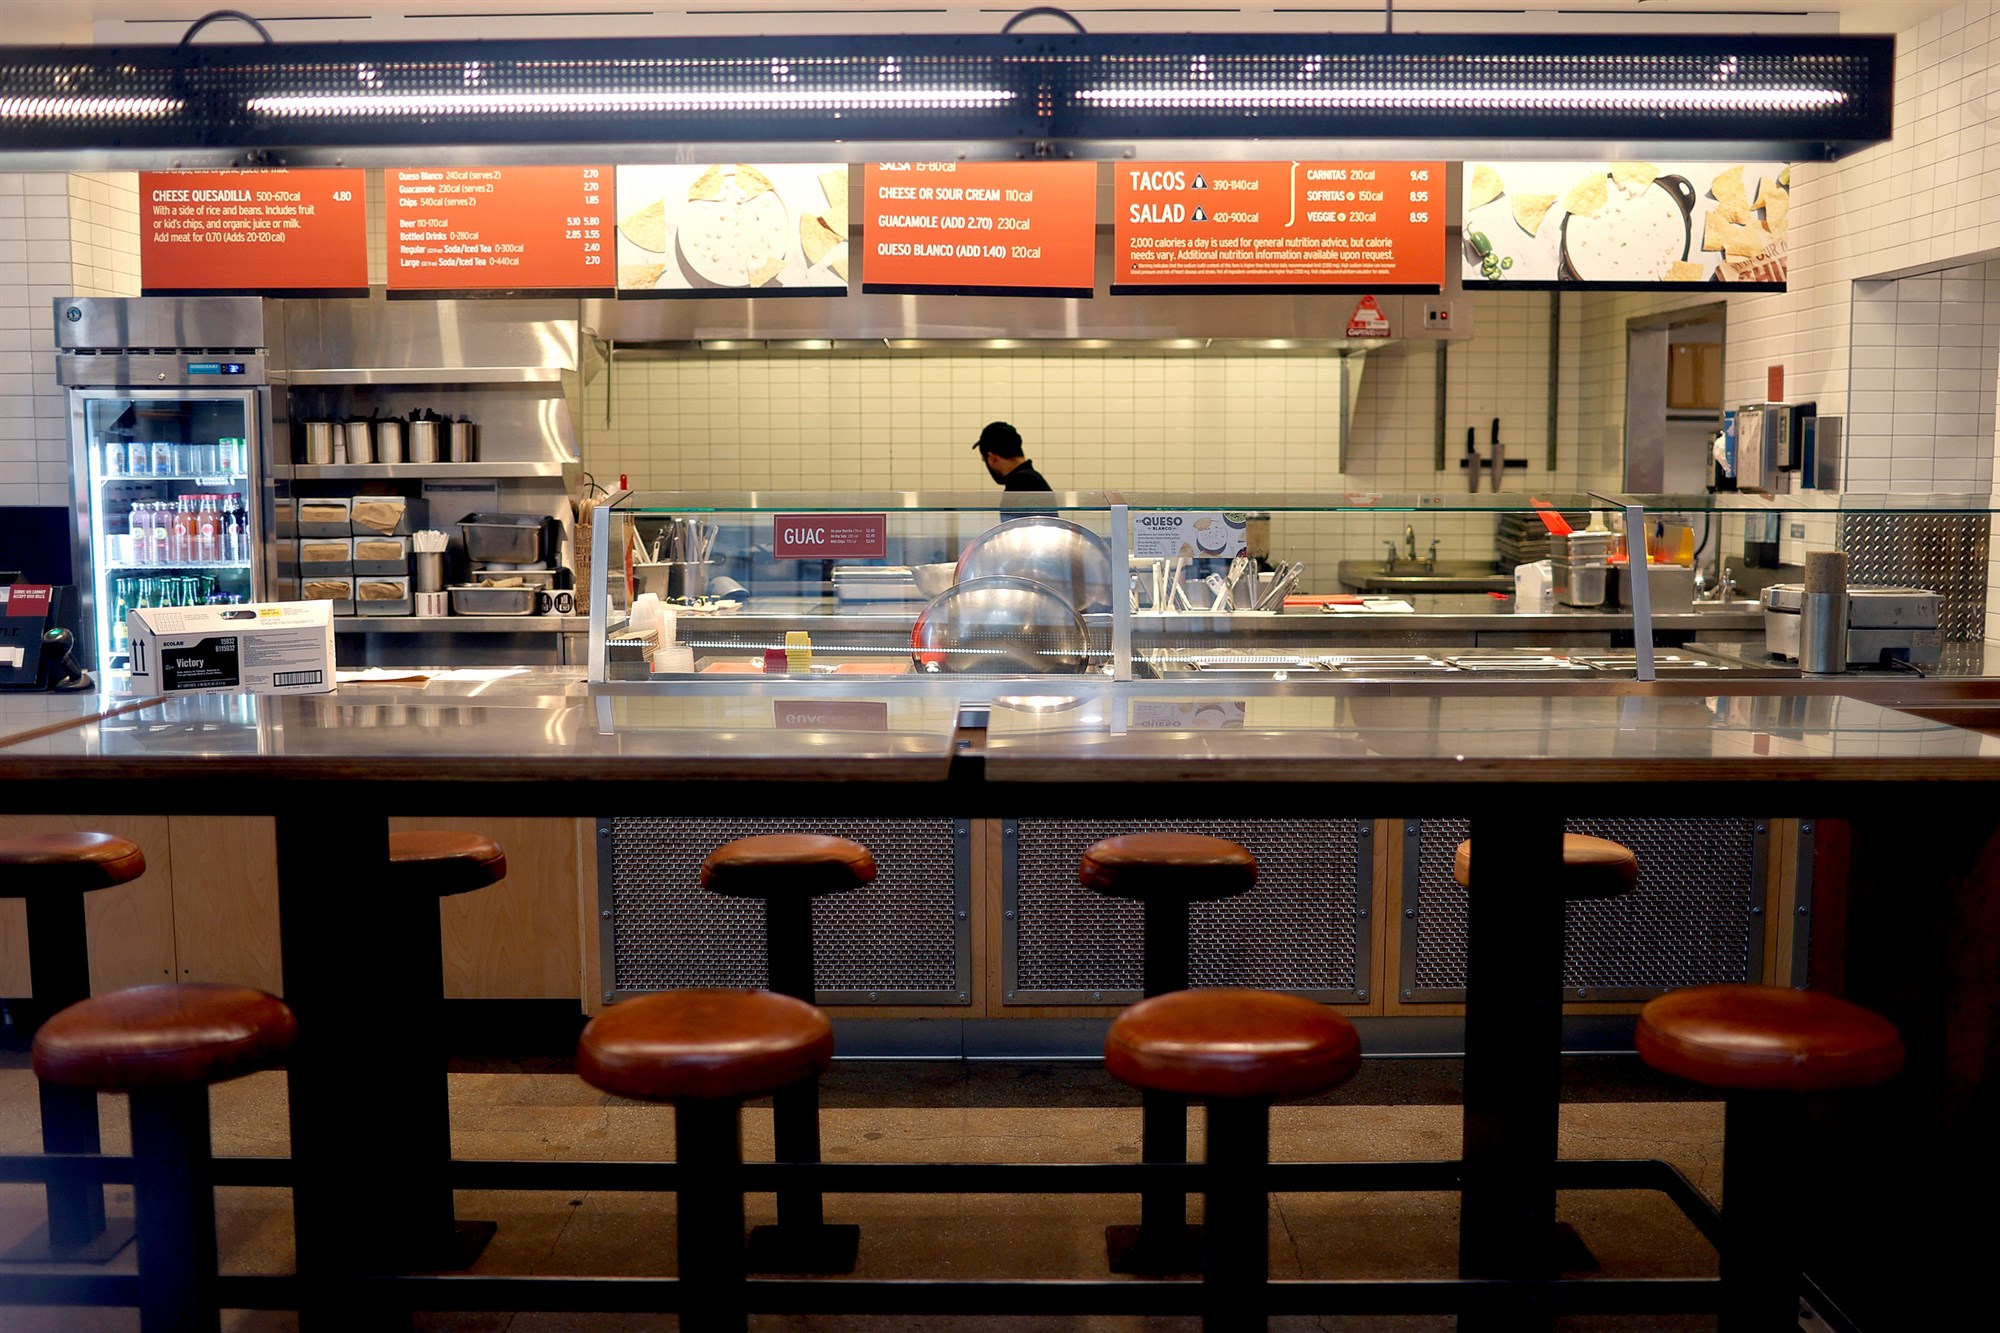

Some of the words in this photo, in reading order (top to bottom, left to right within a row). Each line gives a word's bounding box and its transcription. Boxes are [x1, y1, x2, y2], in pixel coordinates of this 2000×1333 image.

[399, 172, 419, 181] Queso
[421, 172, 443, 181] Blanco
[584, 170, 599, 179] 2.70
[1130, 171, 1185, 191] TACOS
[1307, 170, 1346, 181] CARNITAS
[1410, 171, 1428, 181] 9.45
[399, 185, 436, 194] Guacamole
[584, 183, 599, 192] 2.70
[879, 187, 916, 200] CHEESE
[919, 188, 933, 200] OR
[936, 188, 963, 201] SOUR
[966, 189, 1000, 201] CREAM
[153, 190, 190, 202] CHEESE
[192, 190, 252, 202] QUESADILLA
[333, 191, 352, 201] 4.80
[1307, 191, 1345, 201] SOFRITAS
[1410, 192, 1428, 202] 8.95
[399, 198, 418, 208] Chips
[153, 205, 170, 215] With
[172, 205, 177, 215] a
[179, 205, 195, 215] side
[197, 205, 205, 215] of
[206, 205, 221, 215] rice
[223, 205, 237, 215] and
[239, 205, 264, 215] beans.
[266, 205, 296, 215] Includes
[299, 205, 315, 215] fruit
[1130, 204, 1185, 223] SALAD
[878, 215, 938, 229] GUACAMOLE
[940, 216, 966, 230] (ADD
[968, 217, 993, 231] 2.70)
[1307, 212, 1336, 222] VEGGIE
[1410, 213, 1428, 223] 8.95
[153, 221, 162, 229] or
[164, 218, 181, 229] kid's
[183, 218, 204, 230] chips,
[206, 218, 221, 229] and
[223, 219, 251, 231] organic
[253, 218, 271, 231] juice
[273, 221, 281, 229] or
[283, 218, 301, 229] milk.
[400, 219, 416, 229] Beer
[154, 232, 169, 243] Add
[171, 232, 190, 243] meat
[192, 232, 204, 243] for
[206, 232, 222, 243] 0.70
[224, 232, 245, 243] (Adds
[400, 232, 424, 241] Bottled
[426, 232, 447, 241] Drinks
[1130, 238, 1153, 248] 2,000
[1155, 238, 1186, 248] calories
[1188, 238, 1193, 248] a
[1195, 238, 1209, 248] day
[1211, 238, 1218, 248] is
[1220, 238, 1238, 248] used
[1240, 238, 1252, 248] for
[1254, 238, 1284, 248] general
[1285, 238, 1320, 248] nutrition
[1321, 238, 1349, 248] advice,
[1350, 238, 1364, 248] but
[1365, 238, 1392, 248] calorie
[401, 245, 425, 255] Regular
[444, 244, 478, 254] Soda/Iced
[480, 244, 492, 254] Tea
[584, 243, 600, 252] 2.40
[878, 243, 911, 256] QUESO
[914, 244, 954, 257] BLANCO
[956, 245, 981, 259] (ADD
[983, 246, 1007, 259] 1.40)
[1131, 250, 1155, 260] needs
[1156, 250, 1176, 260] vary.
[1178, 250, 1217, 260] Additional
[1219, 250, 1254, 260] nutrition
[1255, 250, 1301, 260] information
[1303, 250, 1338, 260] available
[1340, 250, 1360, 260] upon
[1362, 250, 1394, 260] request.
[401, 258, 420, 268] Large
[439, 257, 473, 267] Soda/Iced
[474, 257, 486, 267] Tea
[586, 256, 600, 265] 2.70
[1739, 256, 1787, 282] CHI
[1142, 517, 1183, 526] QUESO
[784, 528, 825, 544] GUAC
[176, 658, 204, 668] Victory
